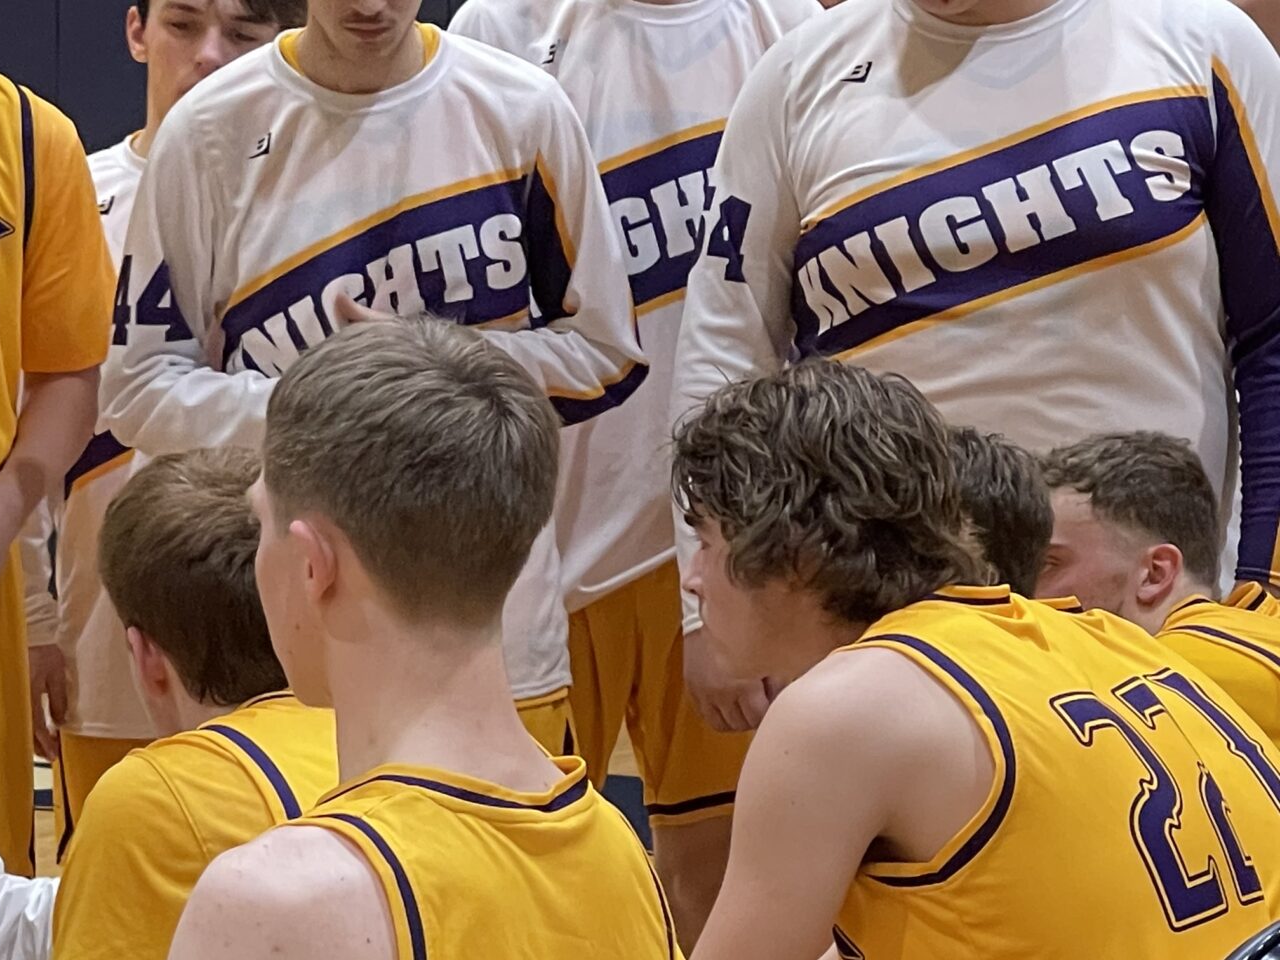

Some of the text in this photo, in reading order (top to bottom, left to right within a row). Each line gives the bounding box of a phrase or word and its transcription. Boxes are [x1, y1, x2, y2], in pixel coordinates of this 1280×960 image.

[226, 213, 528, 378] NIGHTS
[609, 168, 718, 276] GH
[798, 130, 1191, 337] KNIGHTS
